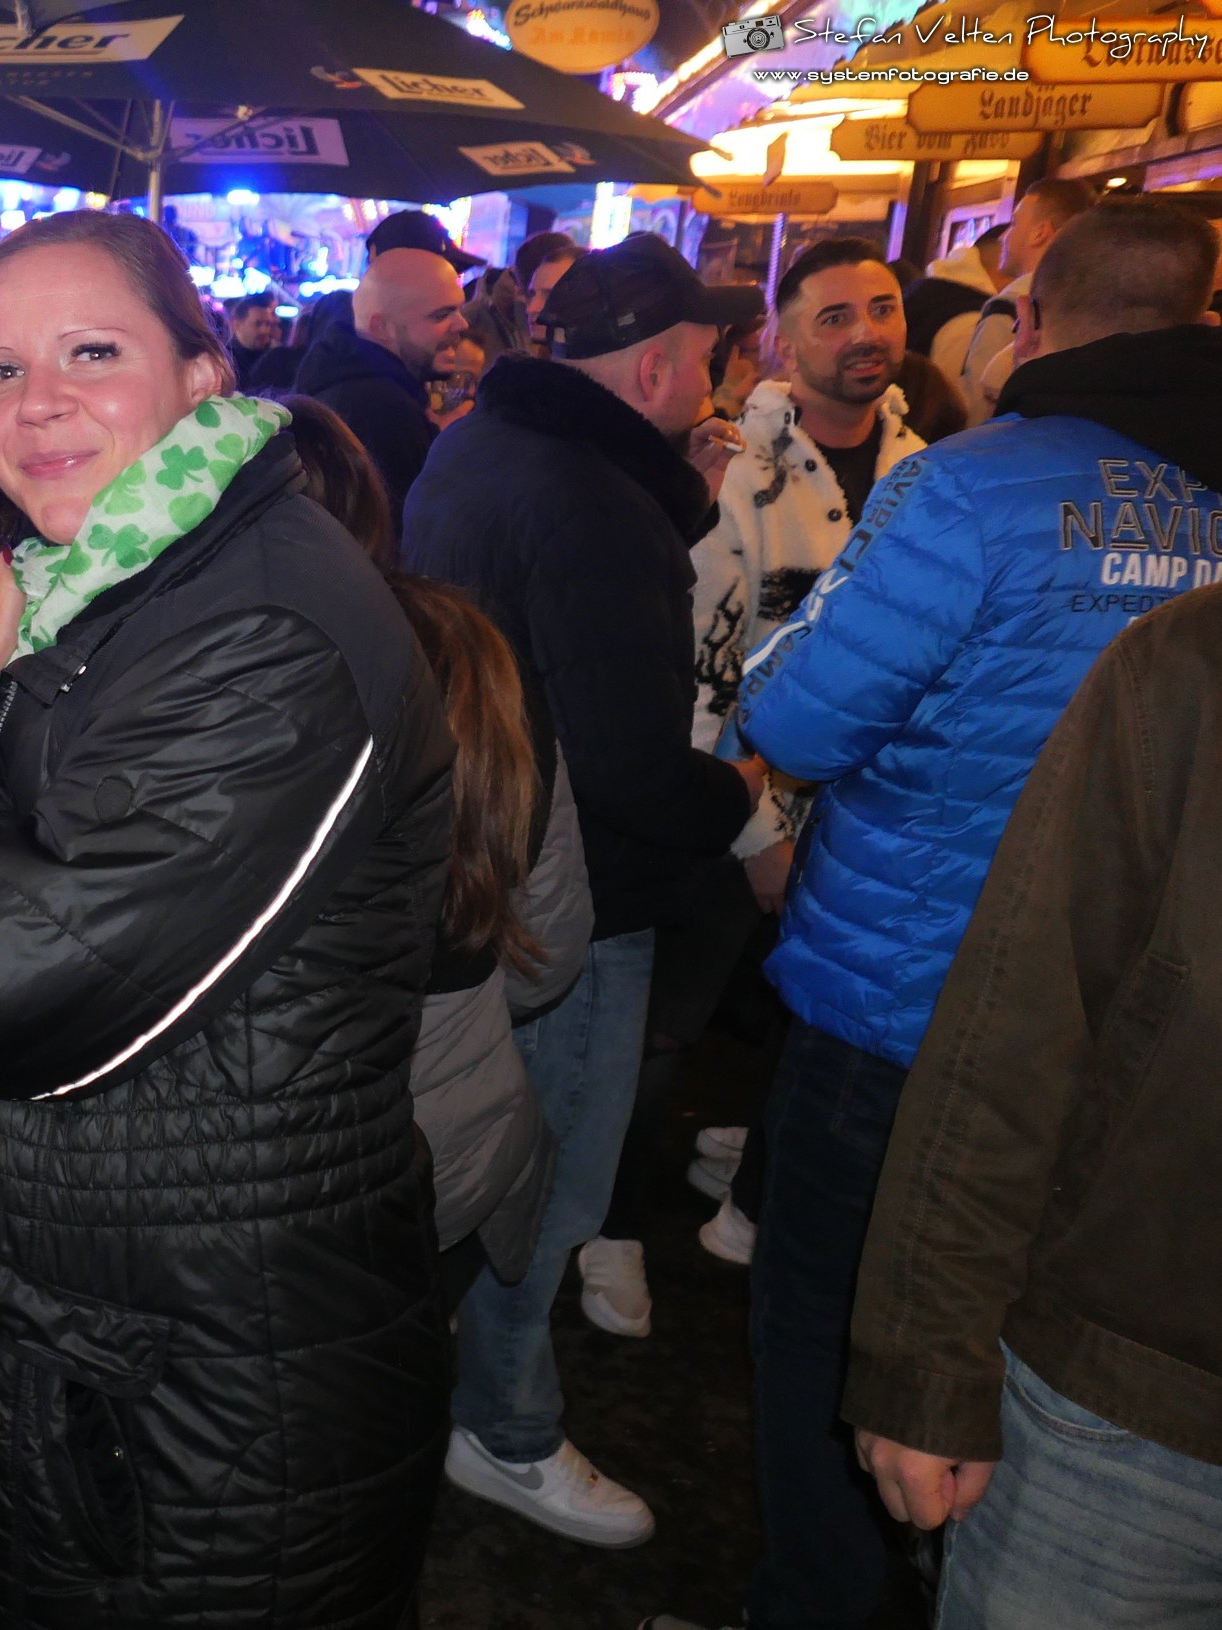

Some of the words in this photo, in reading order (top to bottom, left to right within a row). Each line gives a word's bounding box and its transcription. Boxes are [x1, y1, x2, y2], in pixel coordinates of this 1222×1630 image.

[380, 72, 487, 98] Licher
[979, 85, 1092, 127] Landjäger
[864, 123, 907, 150] Bier
[1097, 459, 1222, 503] EXP
[1101, 552, 1188, 588] CAMP
[1072, 594, 1170, 613] EXPED
